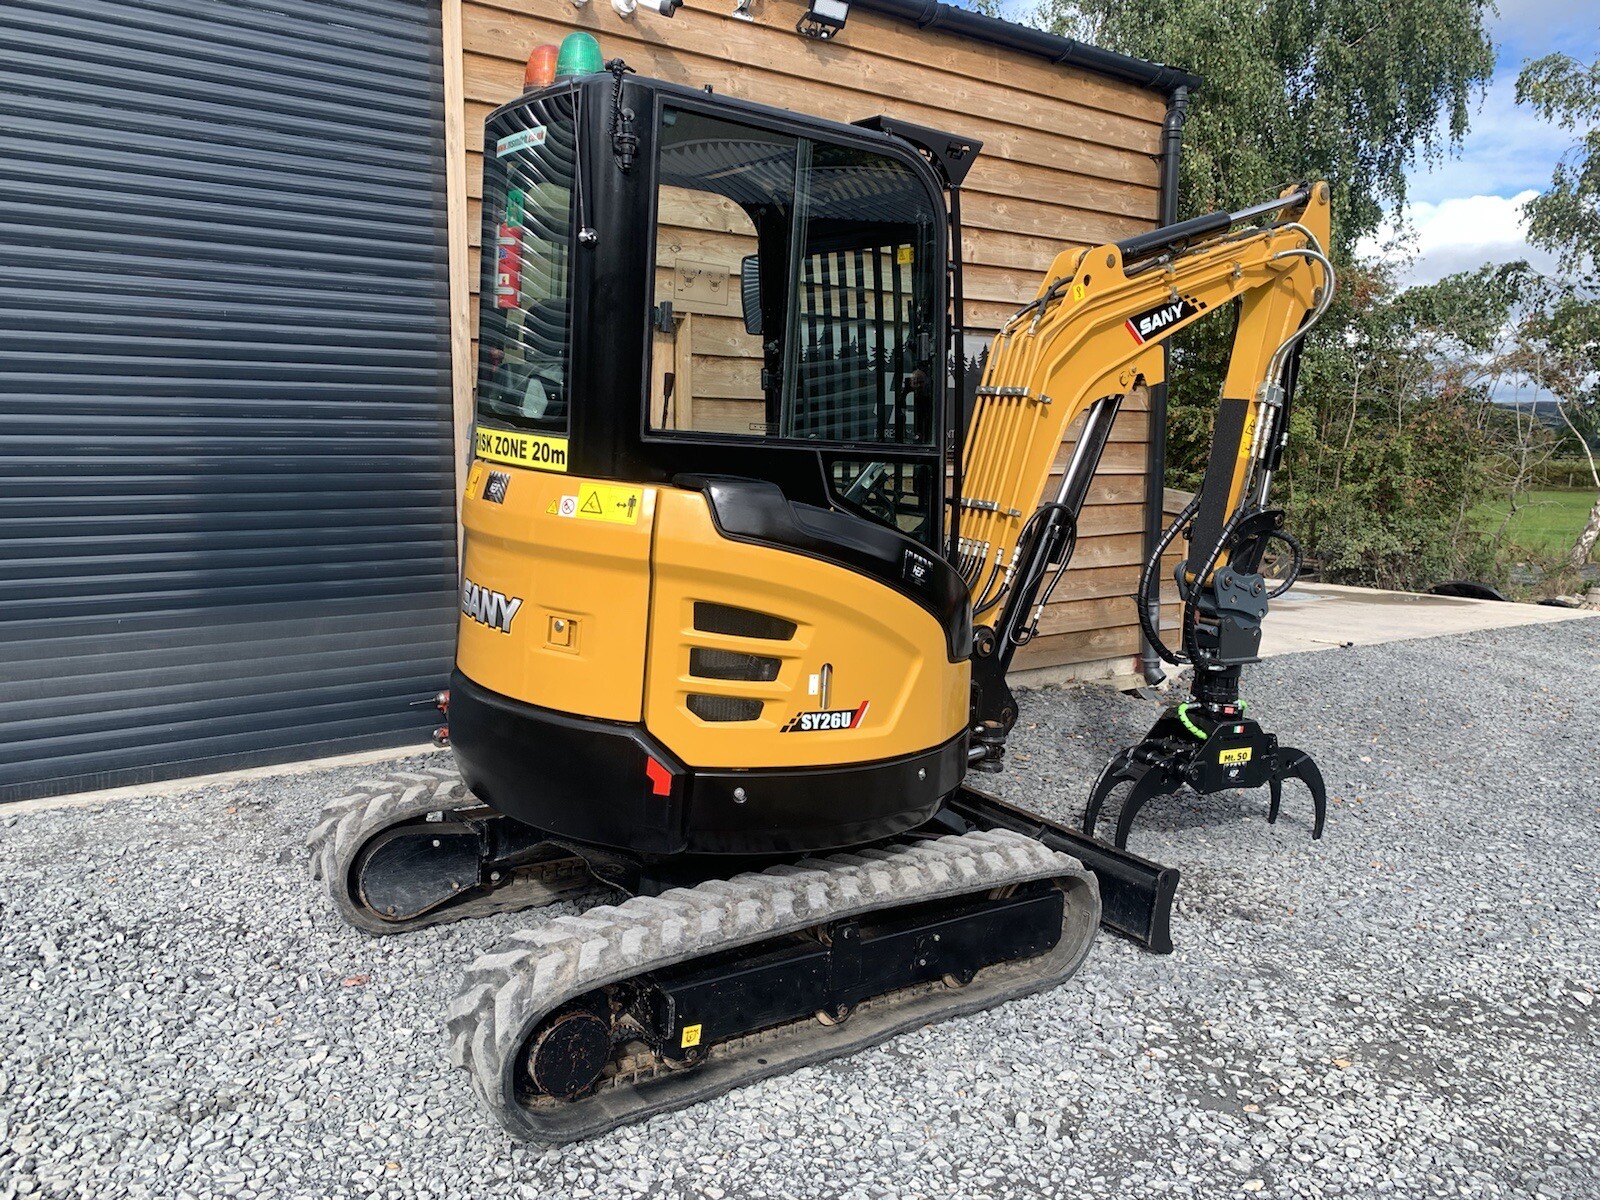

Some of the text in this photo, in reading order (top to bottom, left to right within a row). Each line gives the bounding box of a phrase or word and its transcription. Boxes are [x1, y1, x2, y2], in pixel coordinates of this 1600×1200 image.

[1139, 301, 1183, 336] SANY
[495, 436, 527, 459] ZONE
[532, 441, 565, 465] 20m
[462, 577, 524, 634] SANY
[801, 711, 852, 731] SY26U
[1237, 752, 1248, 761] 50
